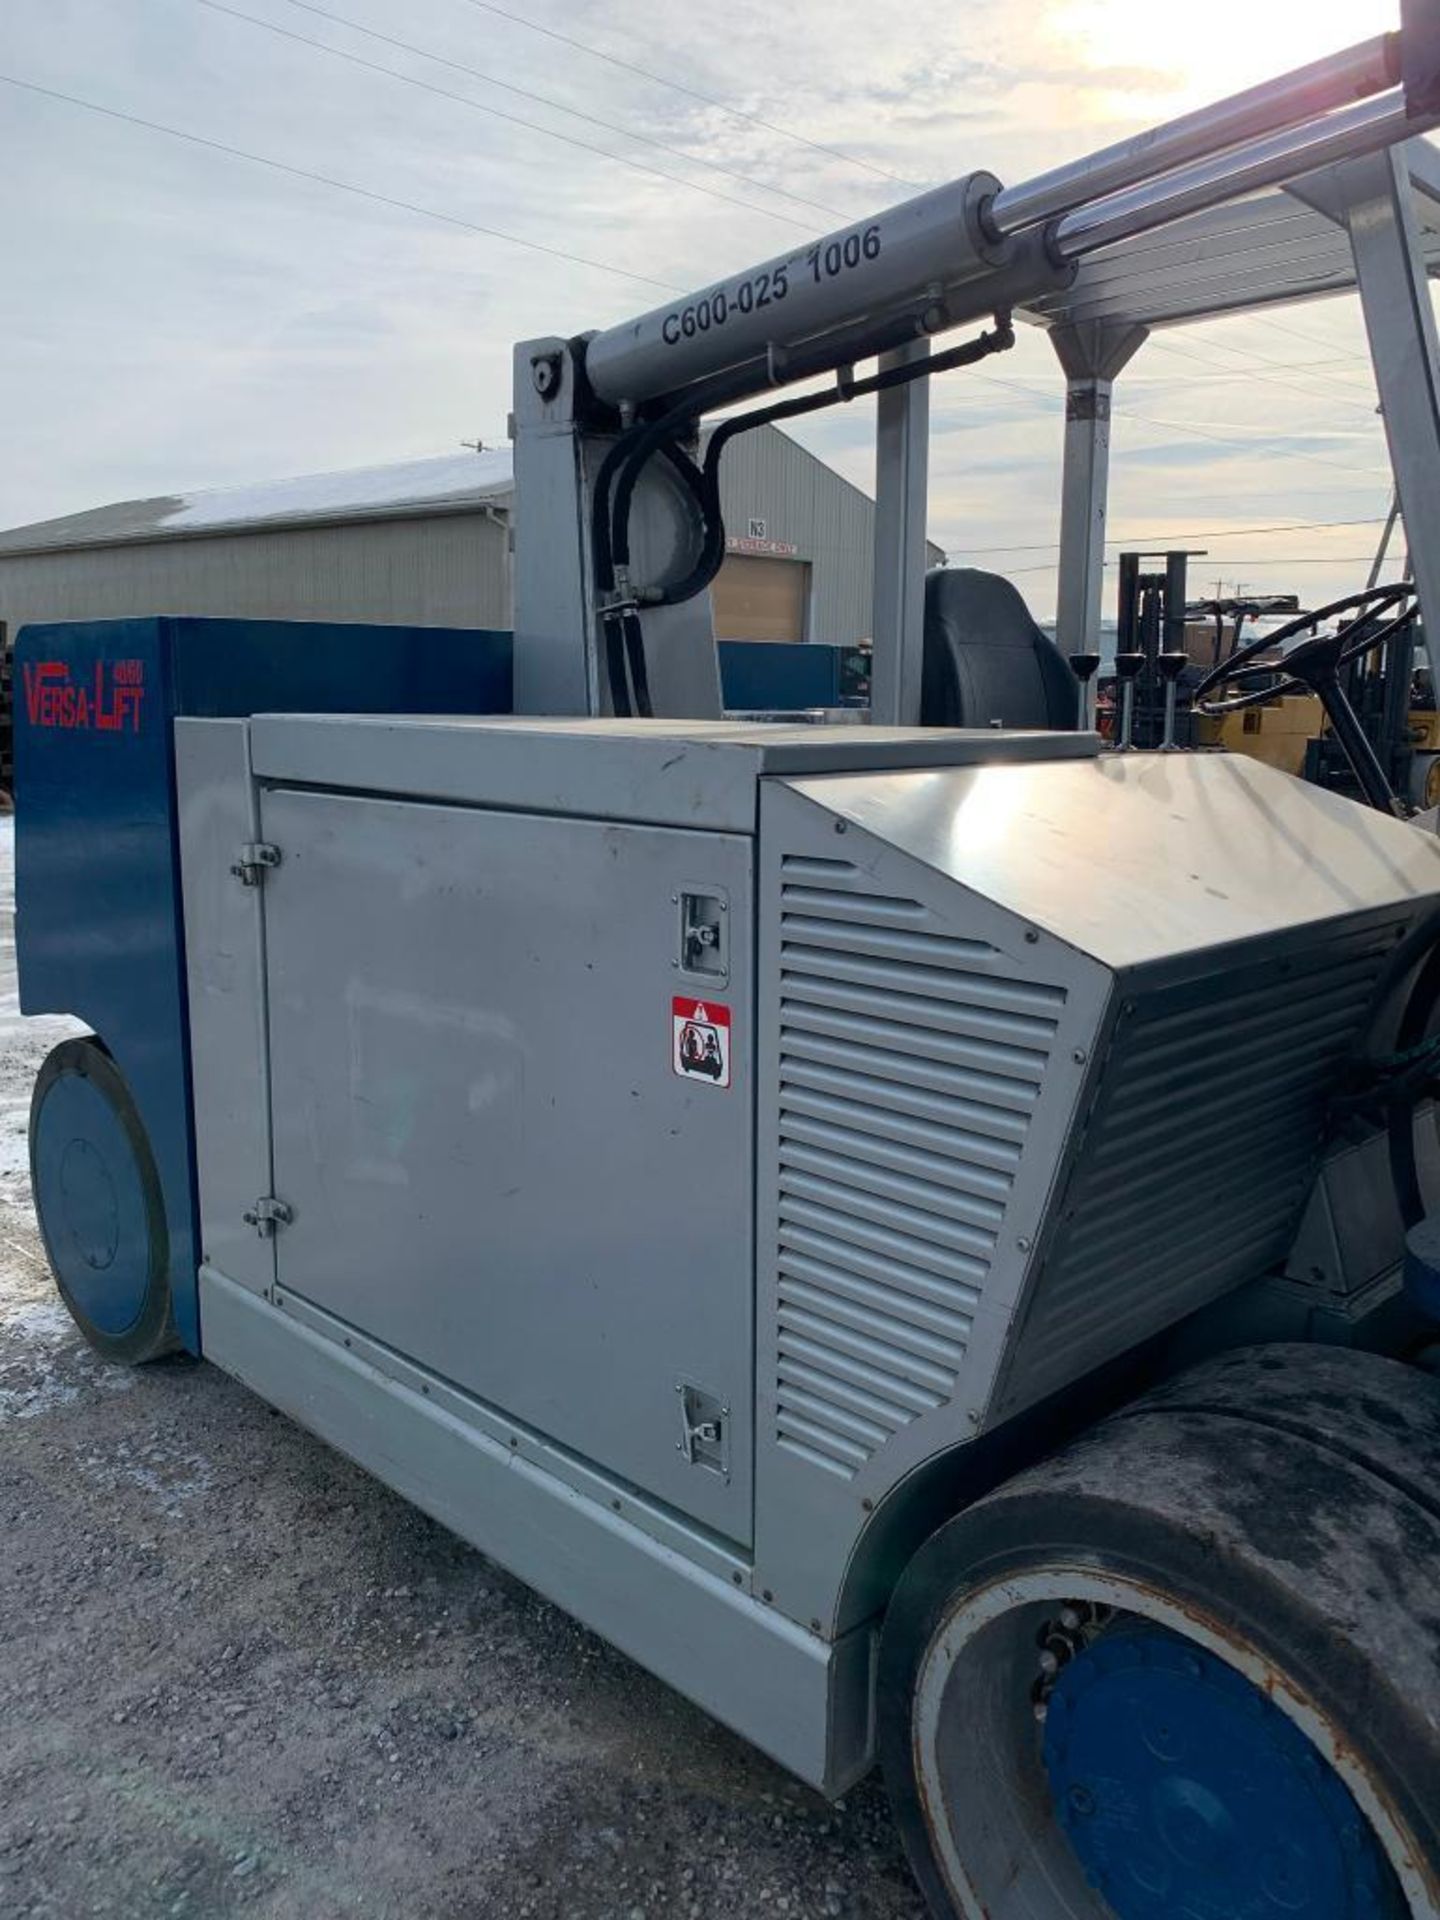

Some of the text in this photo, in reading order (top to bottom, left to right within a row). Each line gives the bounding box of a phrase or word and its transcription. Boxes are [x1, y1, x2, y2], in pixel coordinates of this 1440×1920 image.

[662, 226, 880, 345] C600-025 1006
[750, 520, 765, 537] N3
